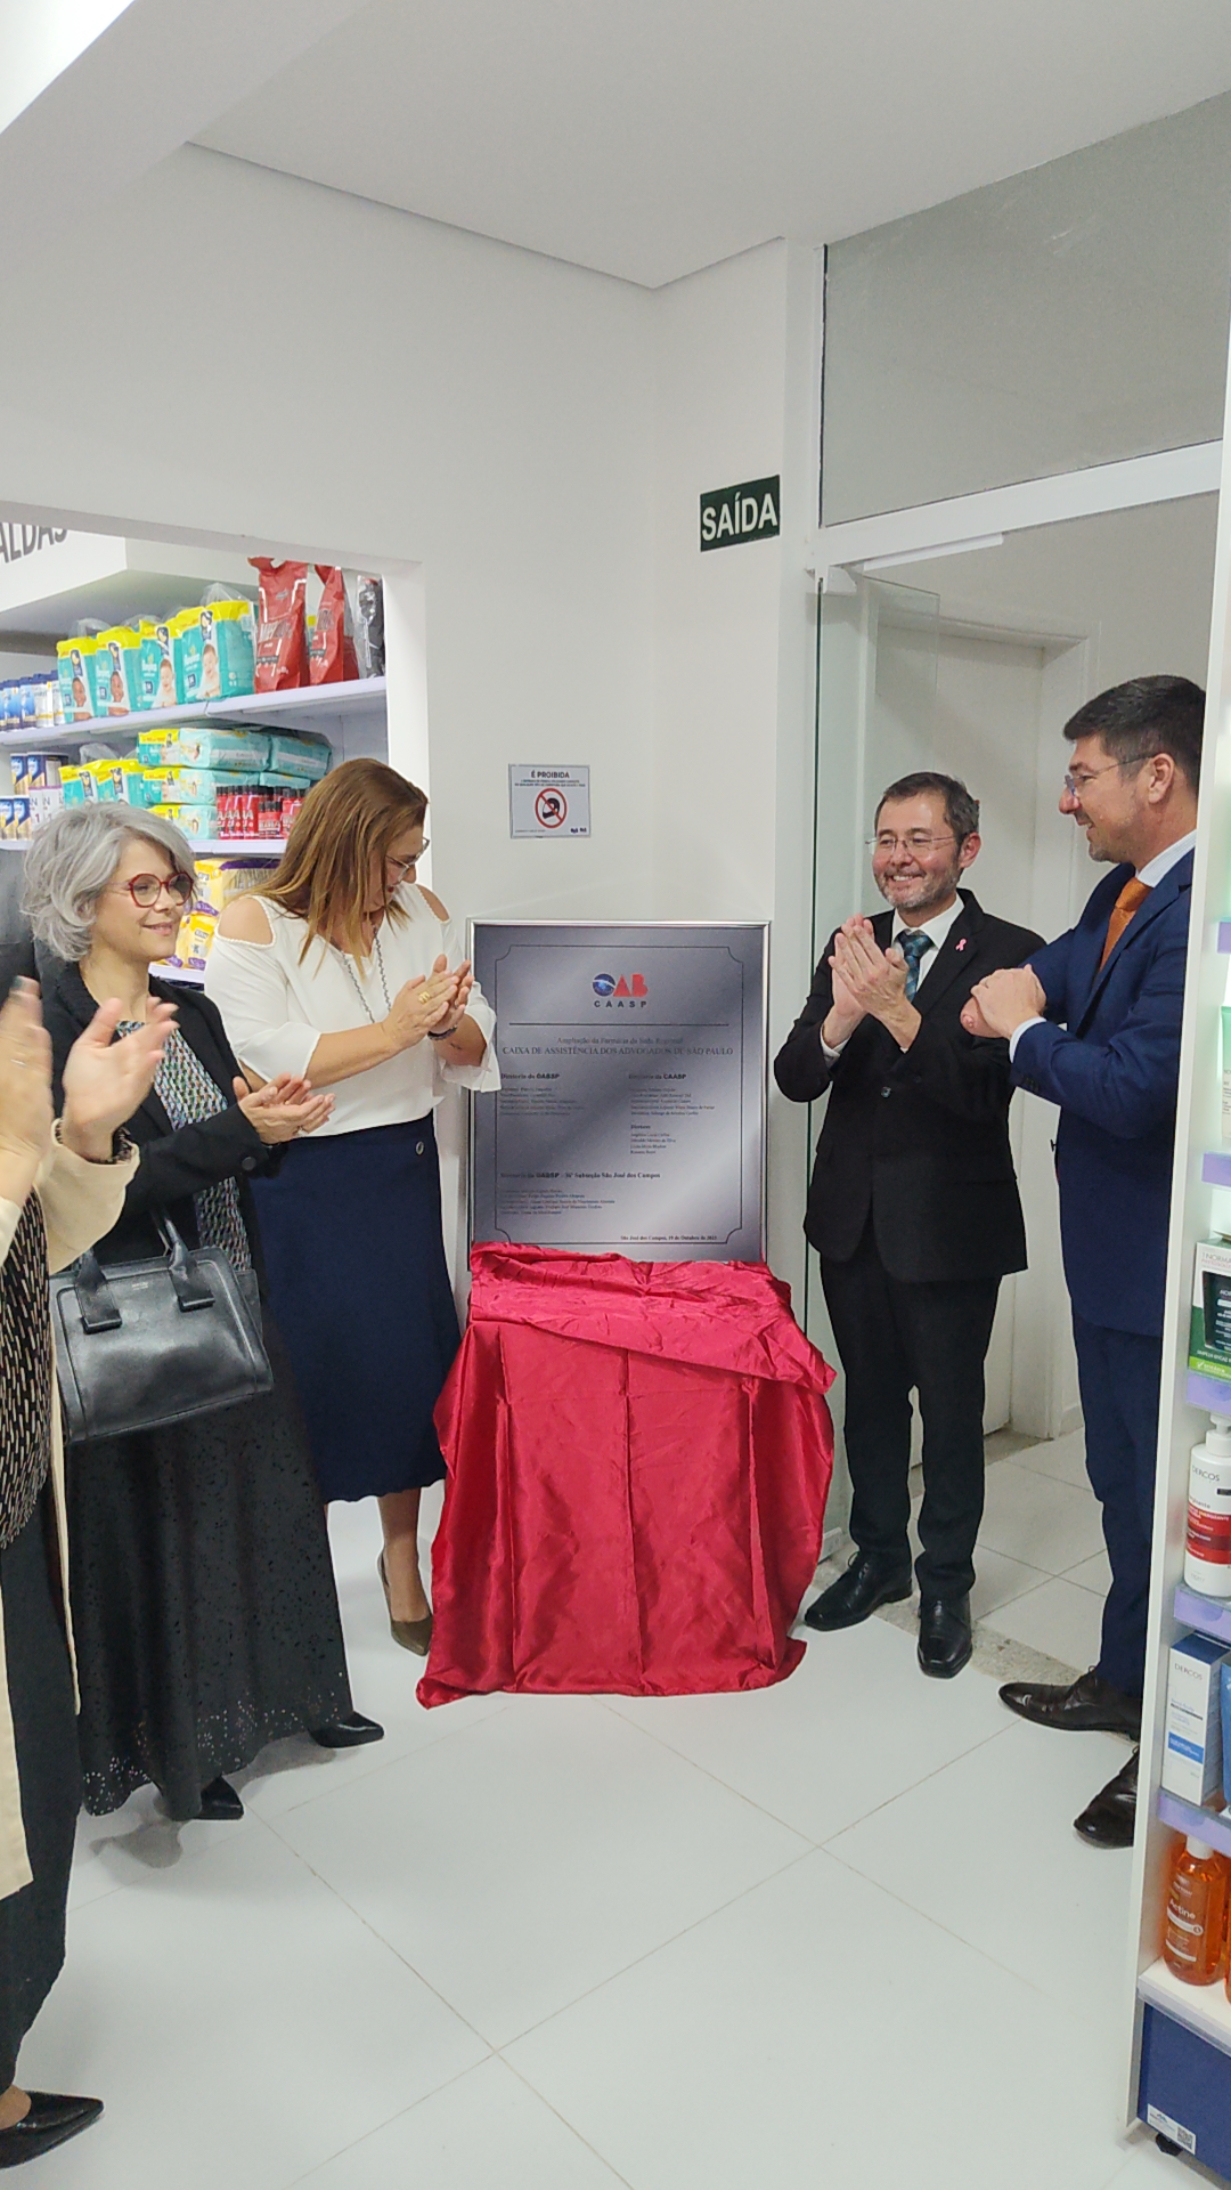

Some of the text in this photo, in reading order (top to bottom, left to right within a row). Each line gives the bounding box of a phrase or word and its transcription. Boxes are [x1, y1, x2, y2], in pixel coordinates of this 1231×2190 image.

[701, 491, 778, 541] SAÍDA
[531, 769, 570, 779] É PROIBIDA
[592, 973, 649, 998] OAB
[594, 1000, 647, 1008] CAASP
[502, 1046, 530, 1055] CAIXA
[531, 1046, 542, 1055] DE
[544, 1045, 600, 1055] ASSISTÊNCIA
[619, 1047, 672, 1056] ADVOGADOS
[705, 1047, 734, 1056] PAULO
[637, 1172, 661, 1180] Campos
[1174, 1662, 1203, 1681] DERCOS
[1169, 1898, 1196, 1920] Actine
